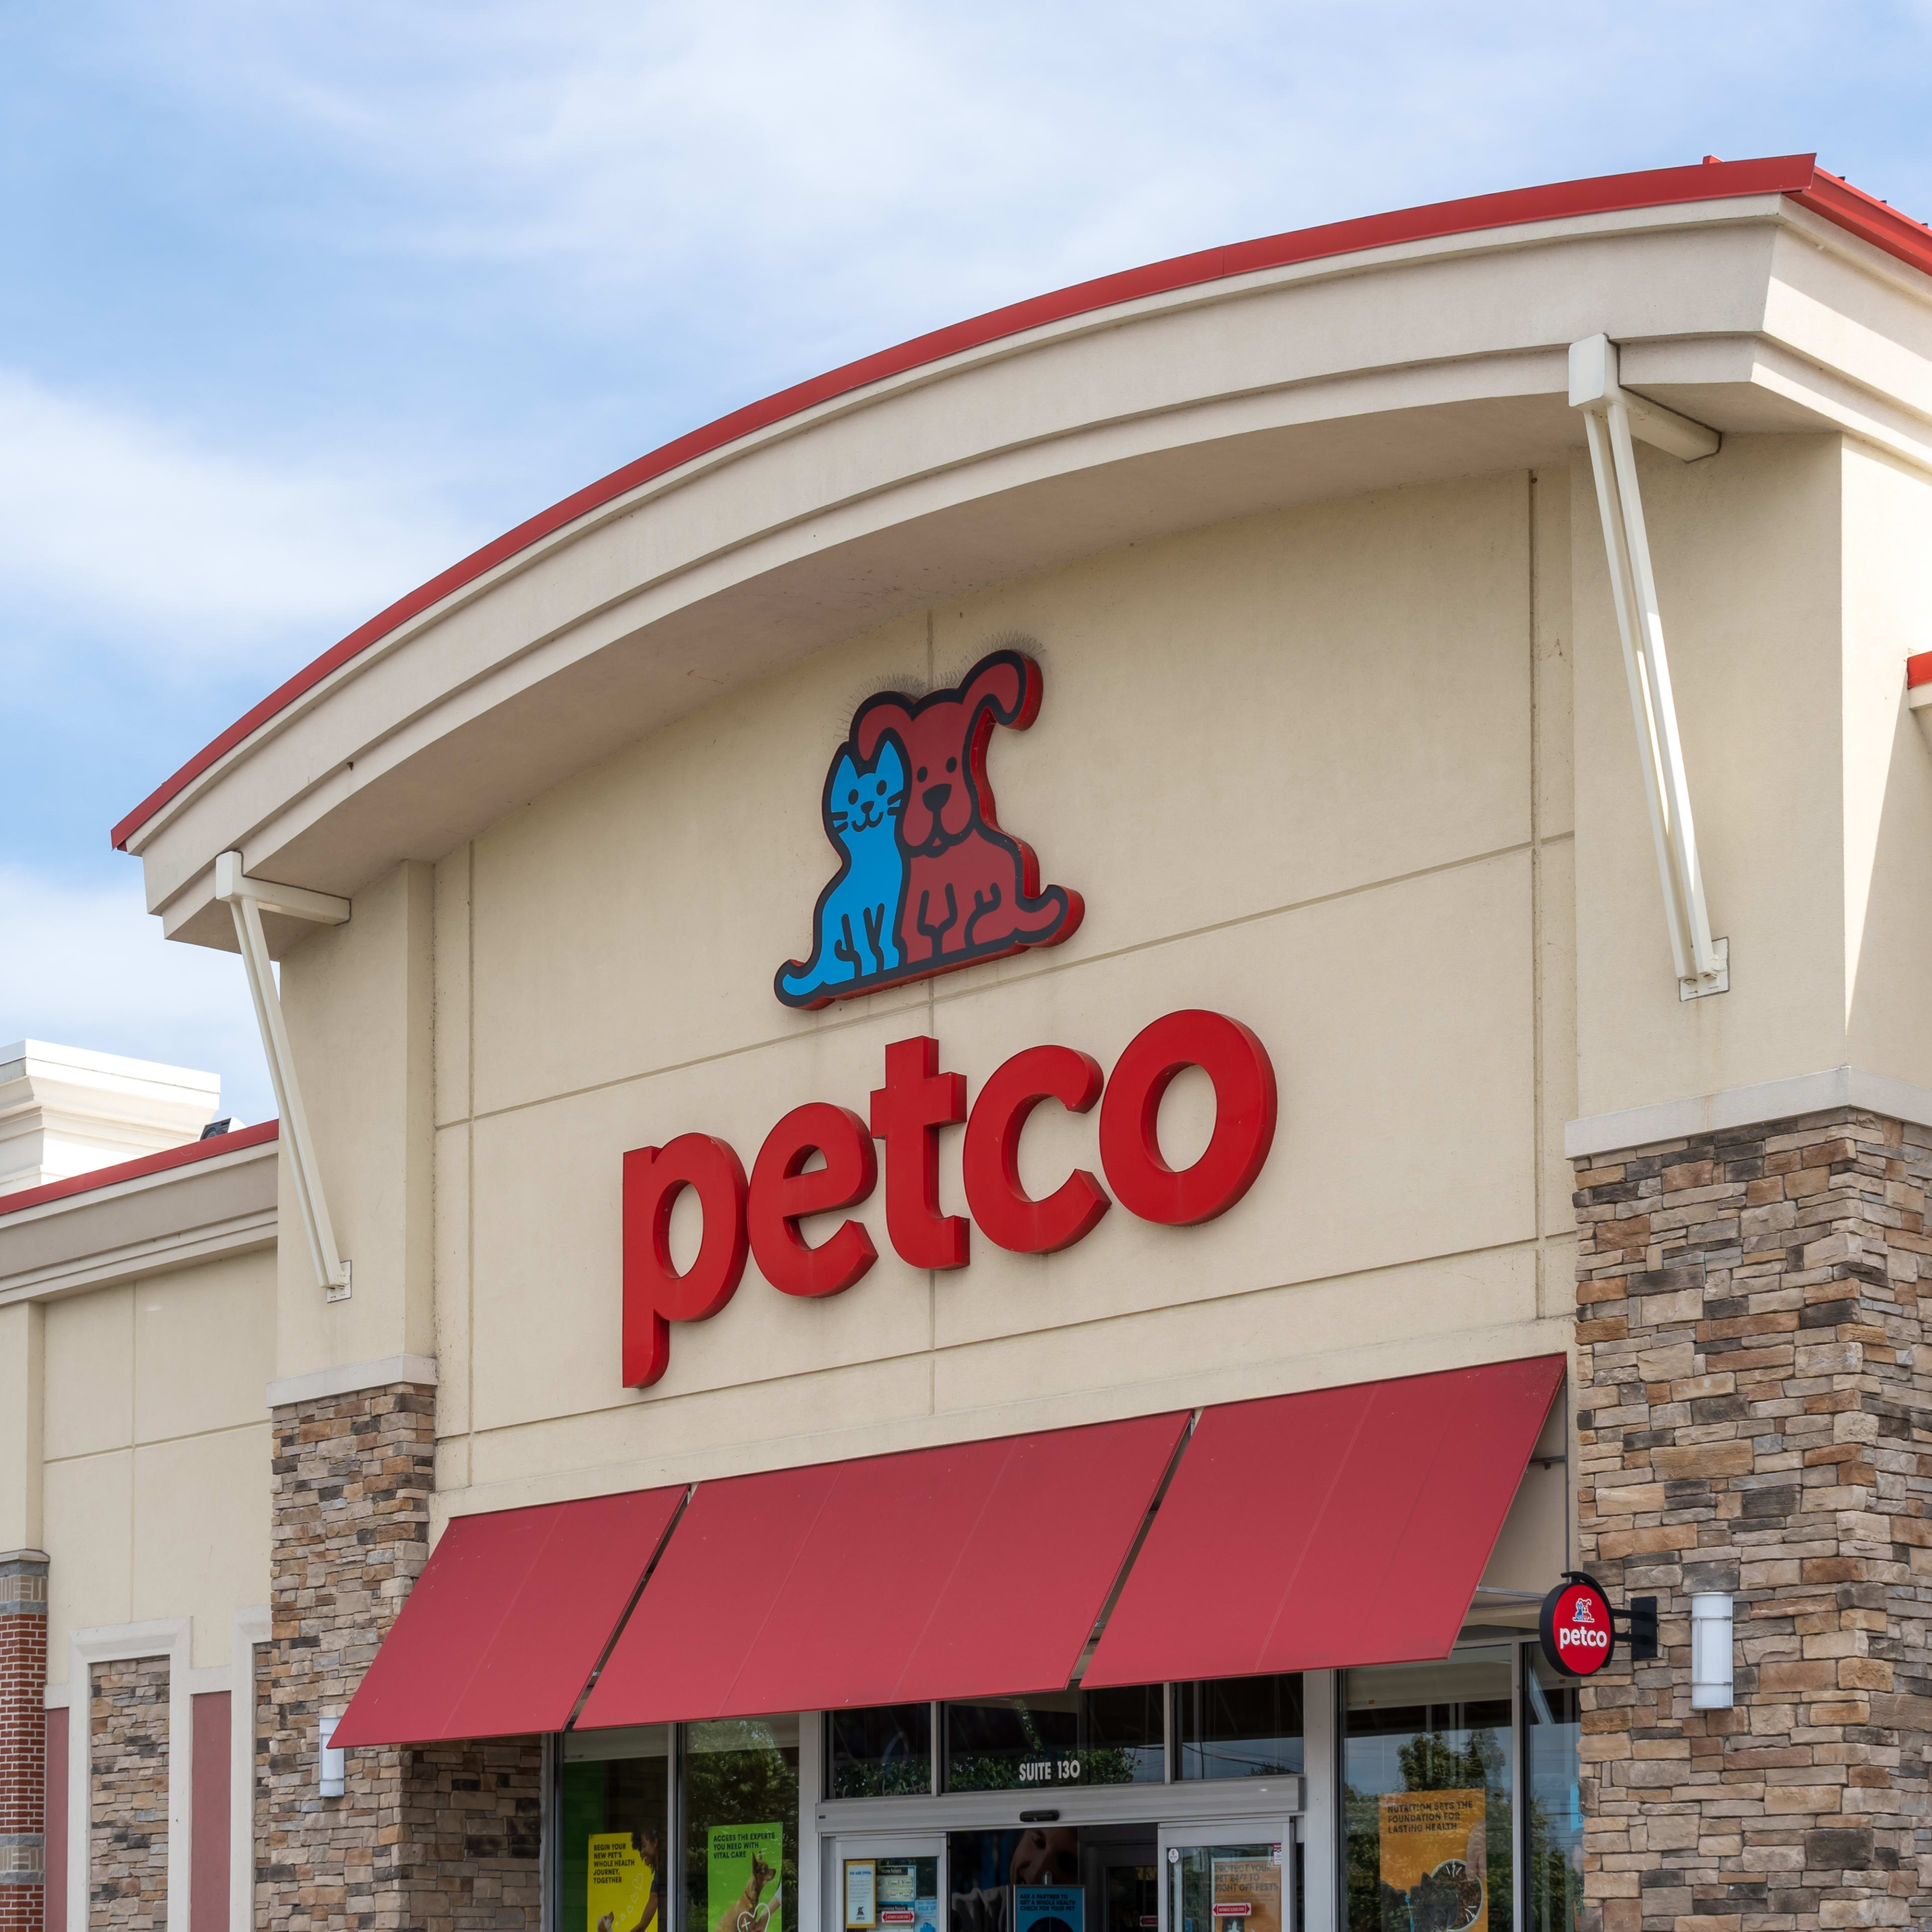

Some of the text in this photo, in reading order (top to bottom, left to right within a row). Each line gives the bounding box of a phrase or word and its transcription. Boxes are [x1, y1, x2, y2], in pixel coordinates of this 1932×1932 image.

[622, 1009, 1278, 1389] petco
[1560, 1626, 1607, 1649] petco
[1019, 1760, 1080, 1781] SUITE 130
[1388, 1801, 1473, 1813] NUTRITION SETS THE
[1388, 1812, 1460, 1823] FOUNDATION FOR
[1389, 1822, 1457, 1833] LASTING HEALTH
[1215, 1864, 1271, 1872] PROTECT YOUR
[1230, 1874, 1247, 1882] 24/7
[1249, 1873, 1260, 1881] TO
[1215, 1884, 1238, 1892] FIGHT
[1239, 1883, 1253, 1891] OFF
